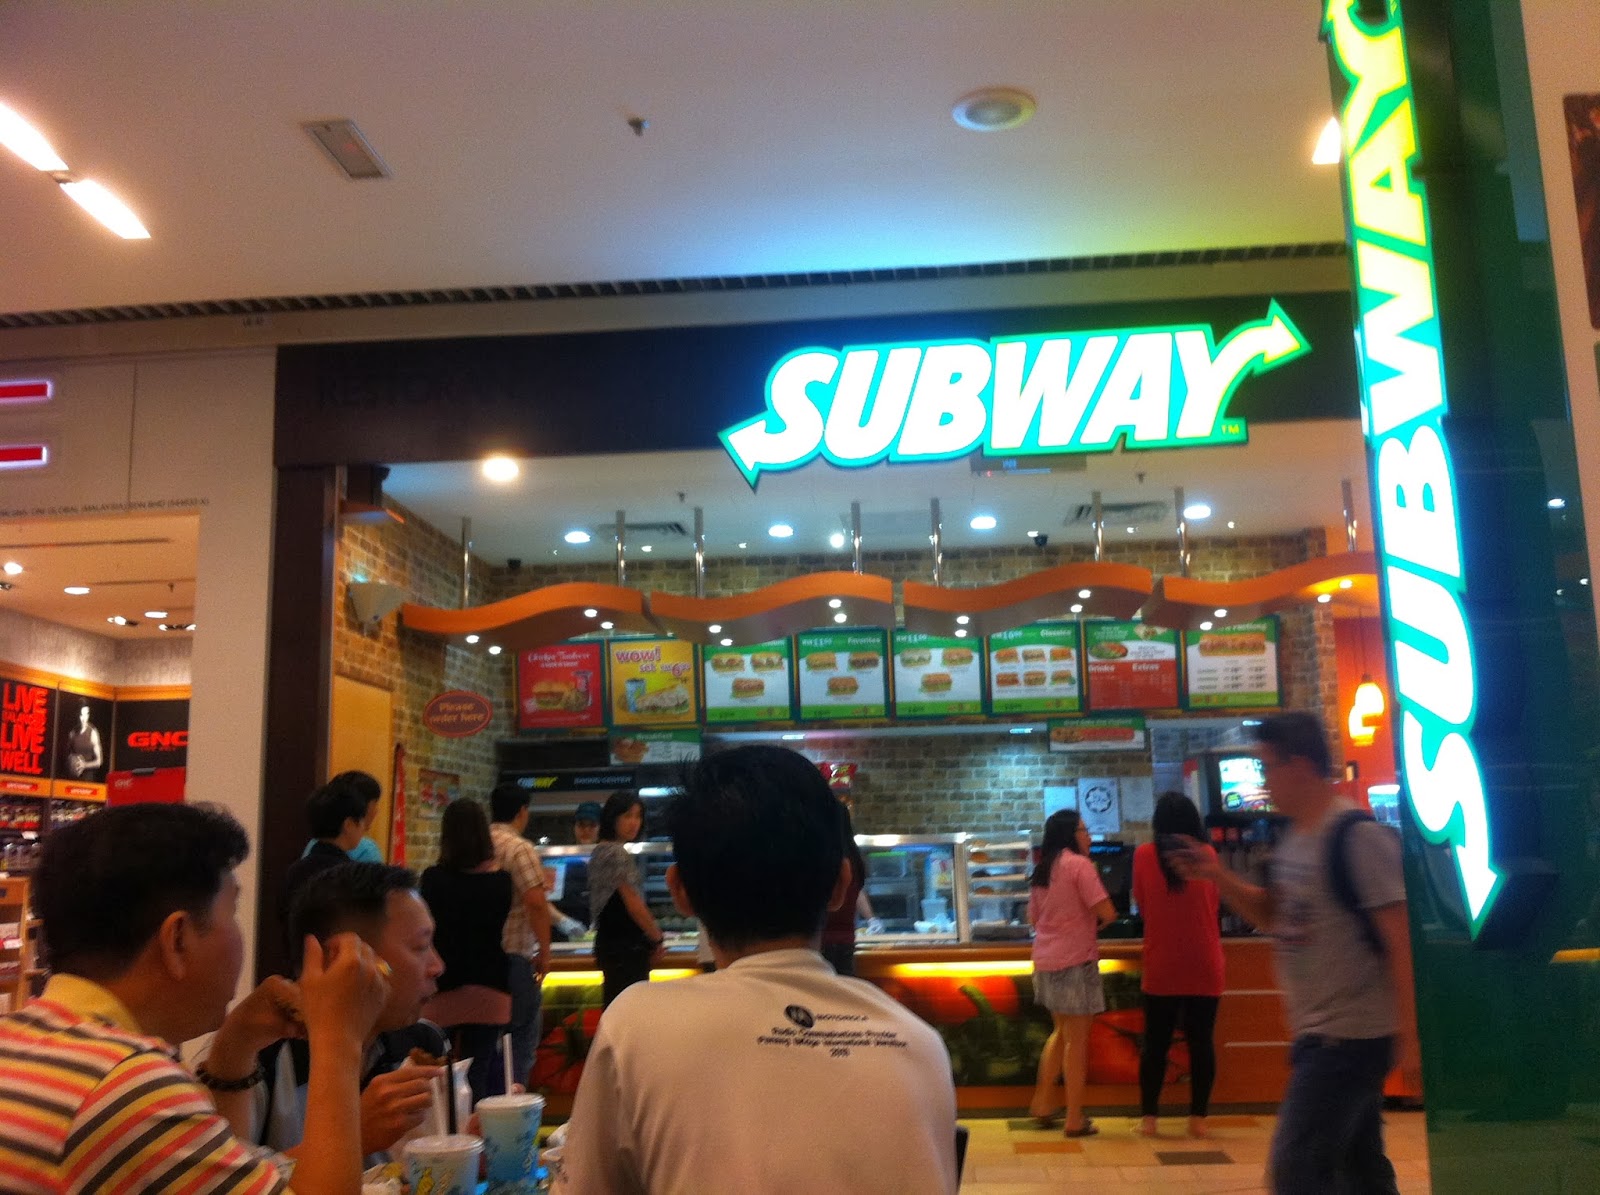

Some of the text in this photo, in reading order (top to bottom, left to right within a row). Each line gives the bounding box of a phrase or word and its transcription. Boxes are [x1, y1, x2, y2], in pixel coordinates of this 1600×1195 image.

[724, 304, 1307, 478] SUBWAY
[1326, 0, 1498, 922] SUBWAY
[3, 682, 49, 713] LIVE
[1, 721, 46, 754] LIVE
[127, 730, 189, 748] GNC
[1, 750, 44, 775] WELL
